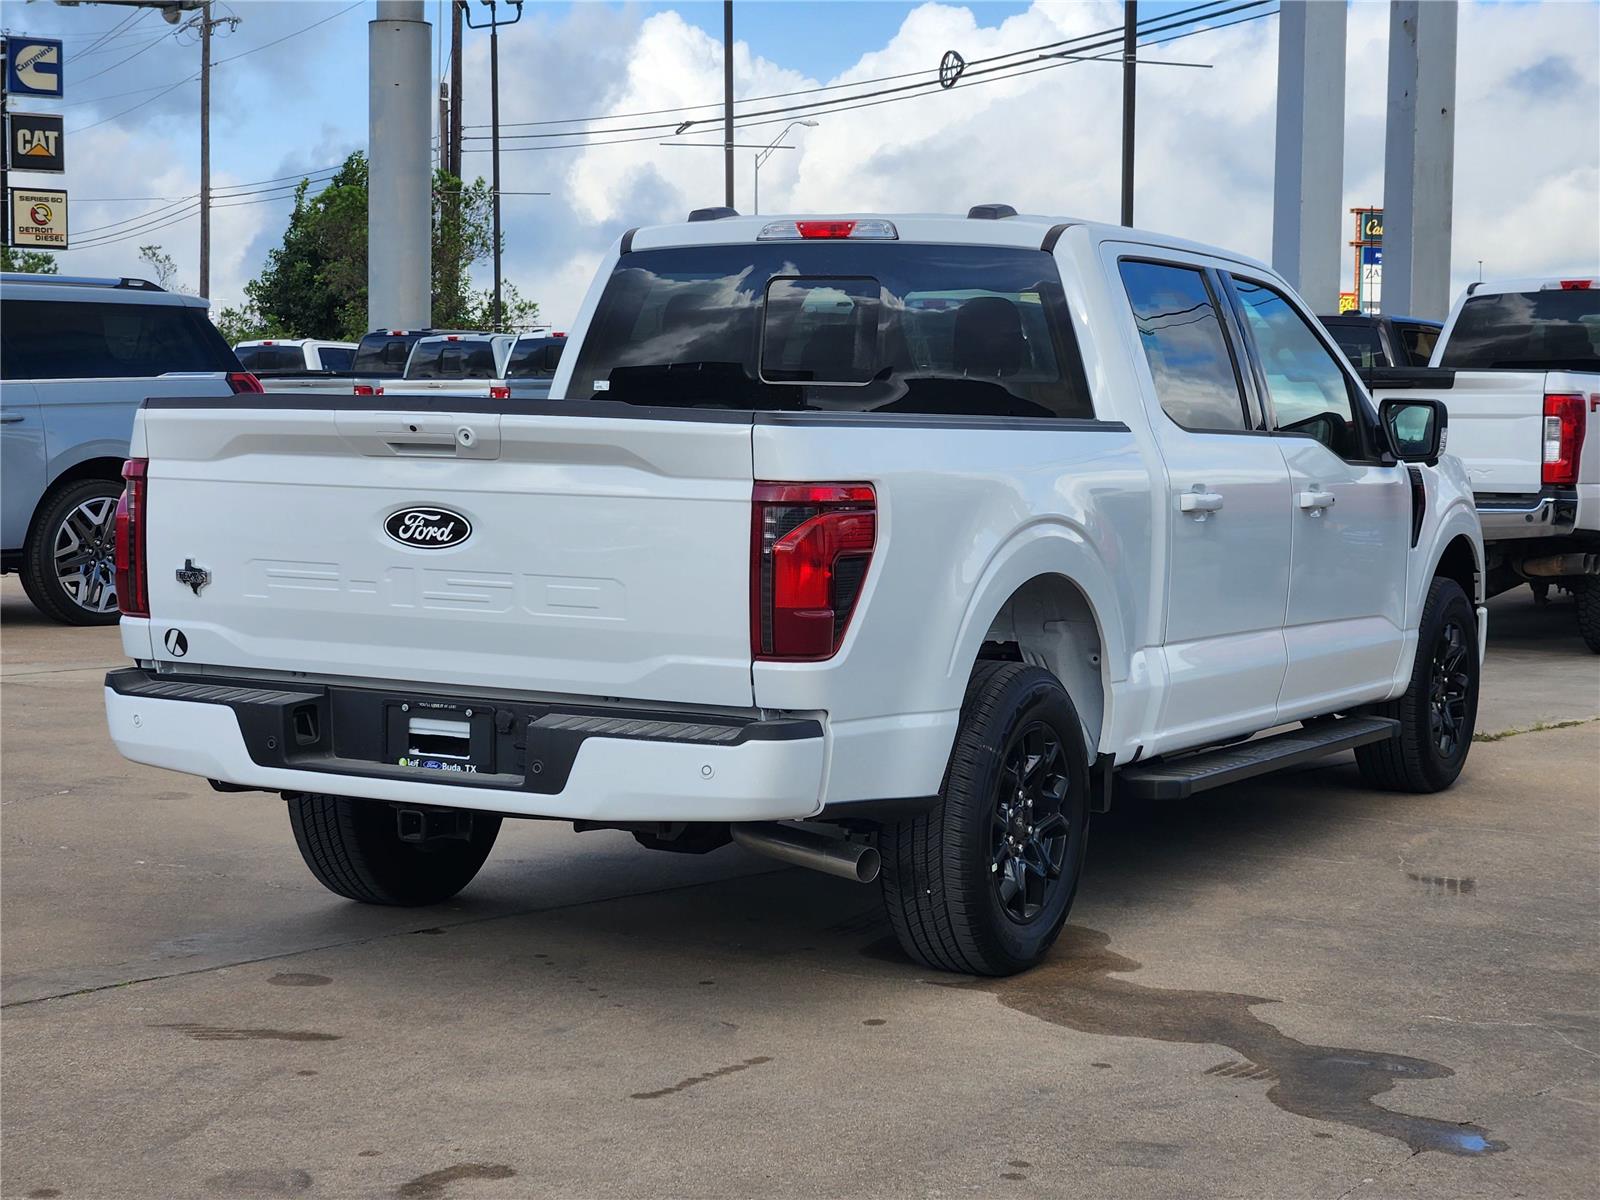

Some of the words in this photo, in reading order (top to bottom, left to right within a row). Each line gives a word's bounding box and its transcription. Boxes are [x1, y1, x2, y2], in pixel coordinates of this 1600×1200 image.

[15, 46, 54, 73] Cummins
[17, 128, 59, 156] CAT
[19, 195, 50, 203] SERIES
[18, 226, 54, 234] DETROIT
[35, 234, 65, 242] DIESEL
[398, 512, 455, 541] Ford
[465, 764, 477, 773] TX
